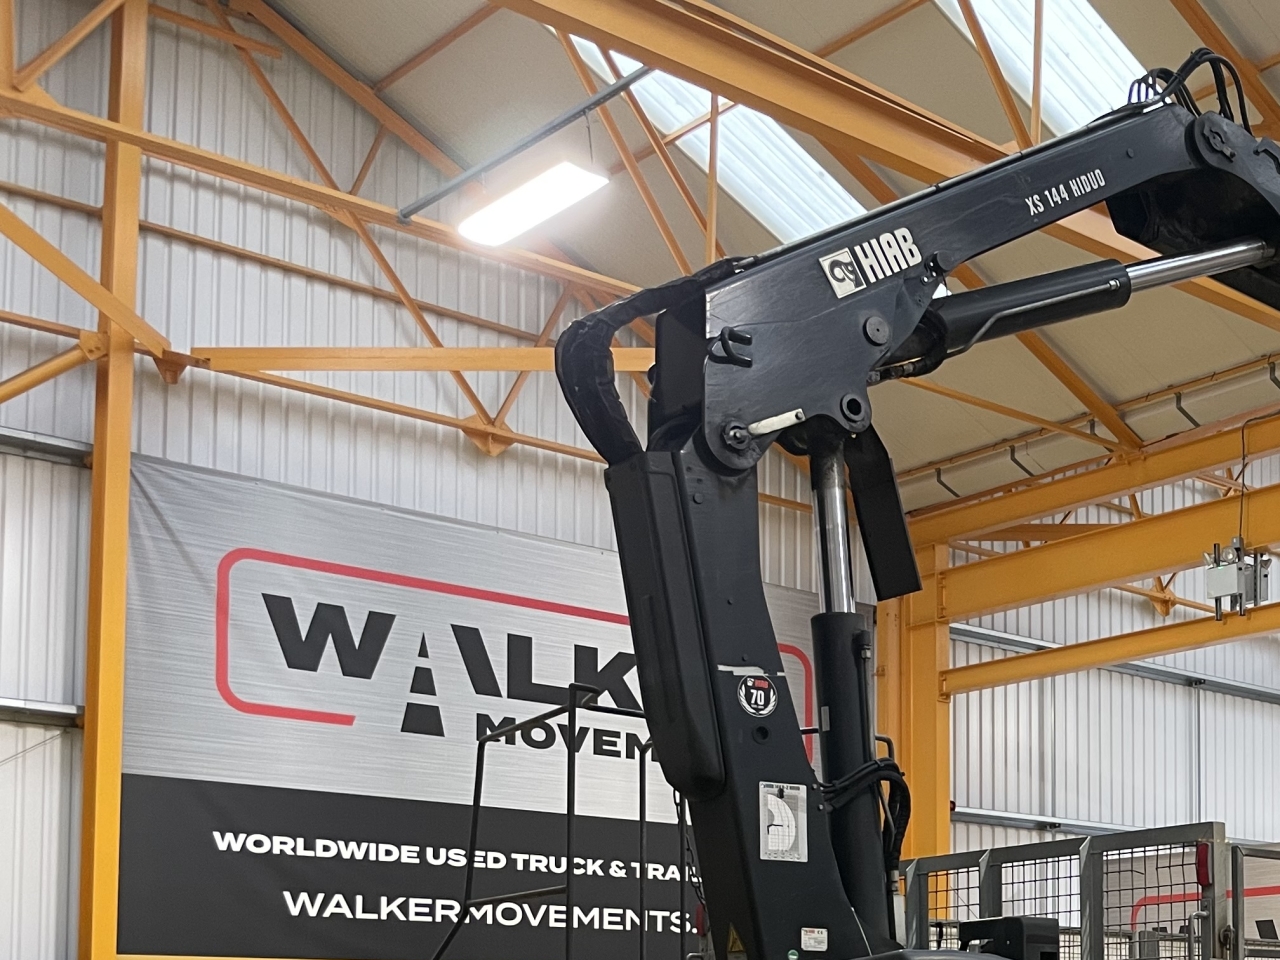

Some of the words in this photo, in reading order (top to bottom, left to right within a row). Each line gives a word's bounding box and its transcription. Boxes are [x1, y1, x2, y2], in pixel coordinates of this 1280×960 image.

[1025, 193, 1045, 216] XS
[1044, 183, 1069, 209] 144
[1068, 168, 1106, 199] HIDUO
[854, 227, 922, 284] HIAB
[750, 689, 765, 705] 70
[212, 831, 420, 864] WORLDWIDE
[426, 847, 507, 869] USED
[511, 853, 605, 877] TRUCK
[609, 861, 627, 878] &
